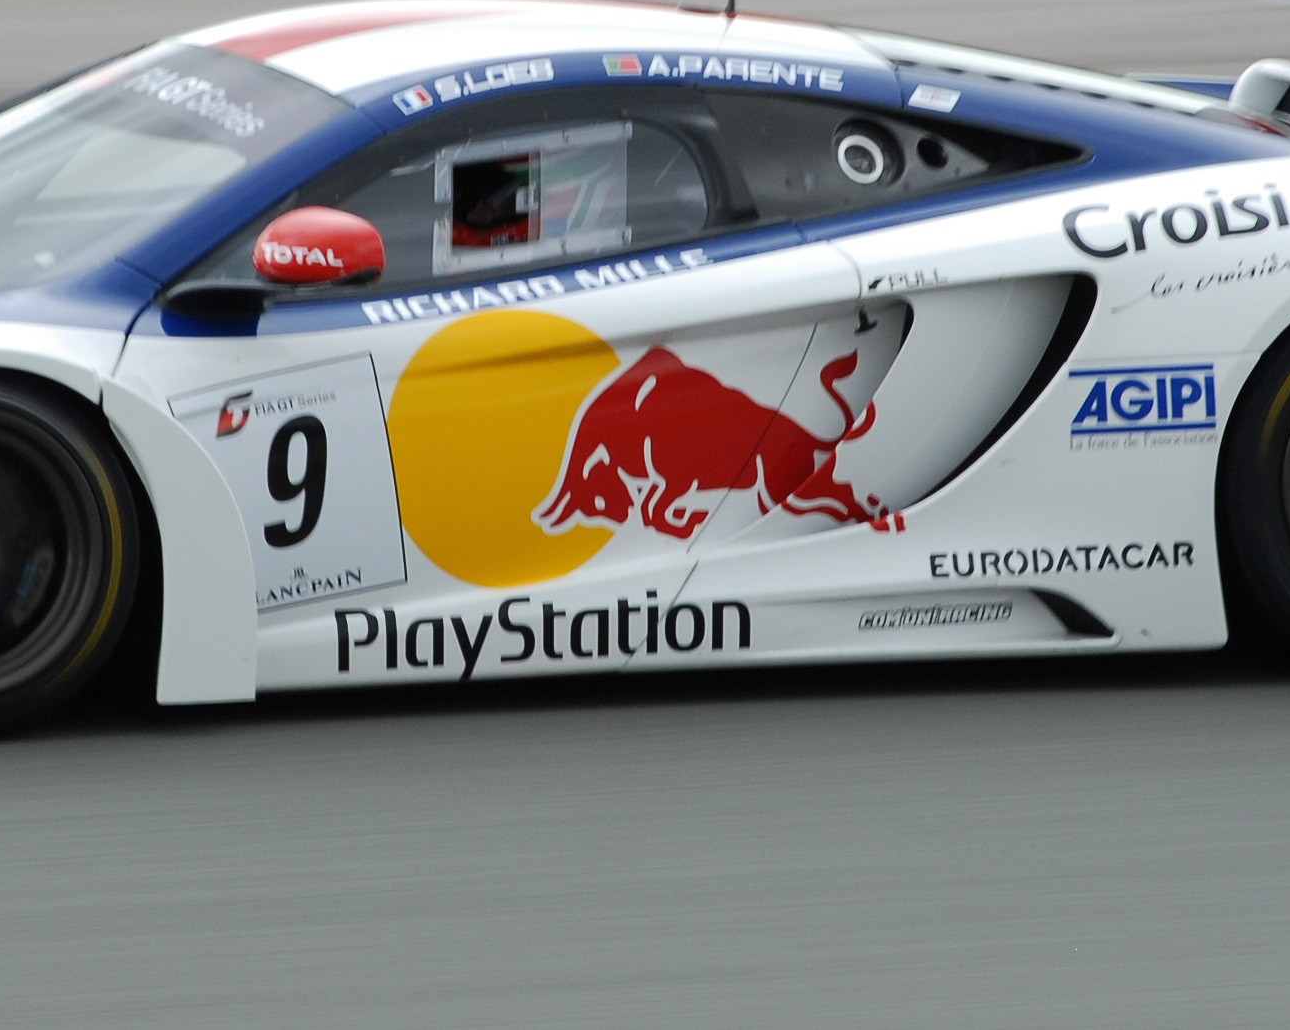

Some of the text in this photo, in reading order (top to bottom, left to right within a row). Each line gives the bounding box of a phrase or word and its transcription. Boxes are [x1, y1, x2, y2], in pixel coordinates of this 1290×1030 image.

[648, 53, 845, 92] A.PARENTE
[261, 241, 344, 268] TOTAL
[360, 248, 713, 325] RICHARD MILLE
[888, 268, 949, 290] PULL
[254, 390, 337, 417] FIA GT Series
[1071, 375, 1217, 424] AGIPI
[262, 414, 329, 549] 9
[928, 542, 1195, 578] EURODATACAR
[255, 567, 362, 605] LANCPAIN
[334, 589, 752, 682] PlayStation
